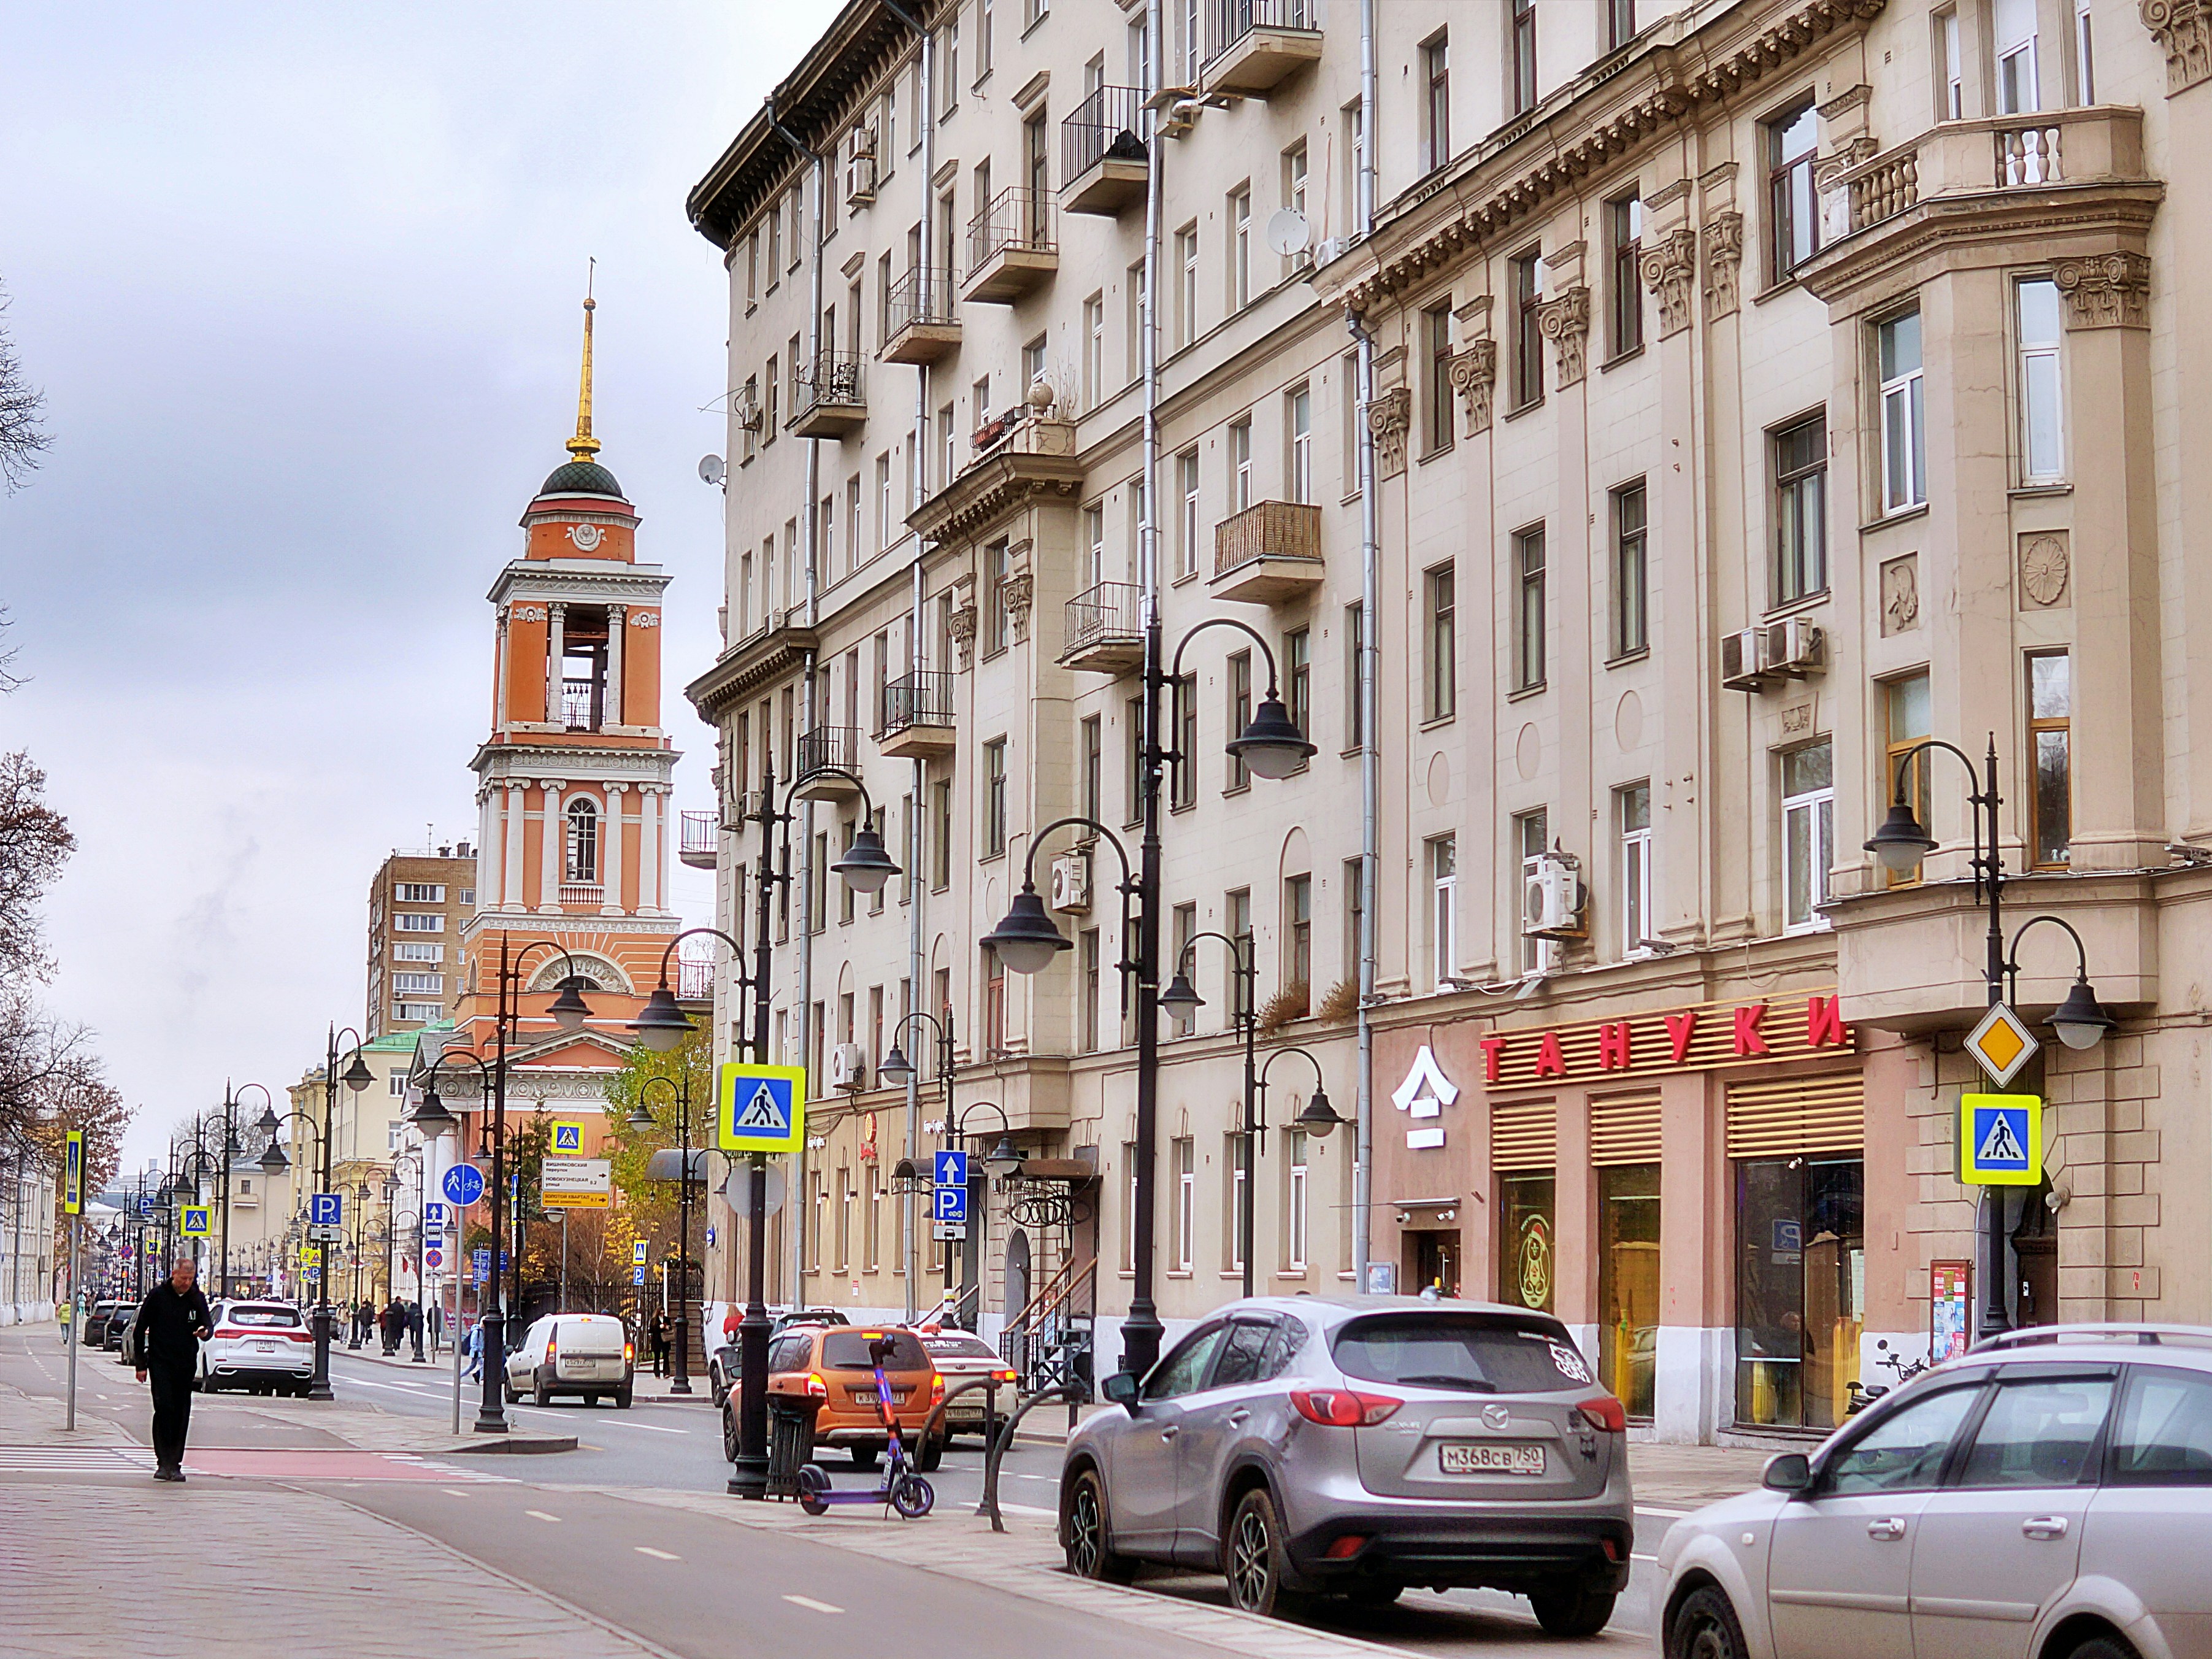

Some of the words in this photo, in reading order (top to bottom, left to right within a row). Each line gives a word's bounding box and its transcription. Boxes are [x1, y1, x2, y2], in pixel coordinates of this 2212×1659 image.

[1480, 994, 1847, 1082] ТАНУКИ
[318, 1197, 336, 1222] P
[940, 1191, 958, 1218] P
[636, 1268, 642, 1283] P
[1447, 1448, 1511, 1466] М368СВ
[1516, 1447, 1539, 1462] 750
